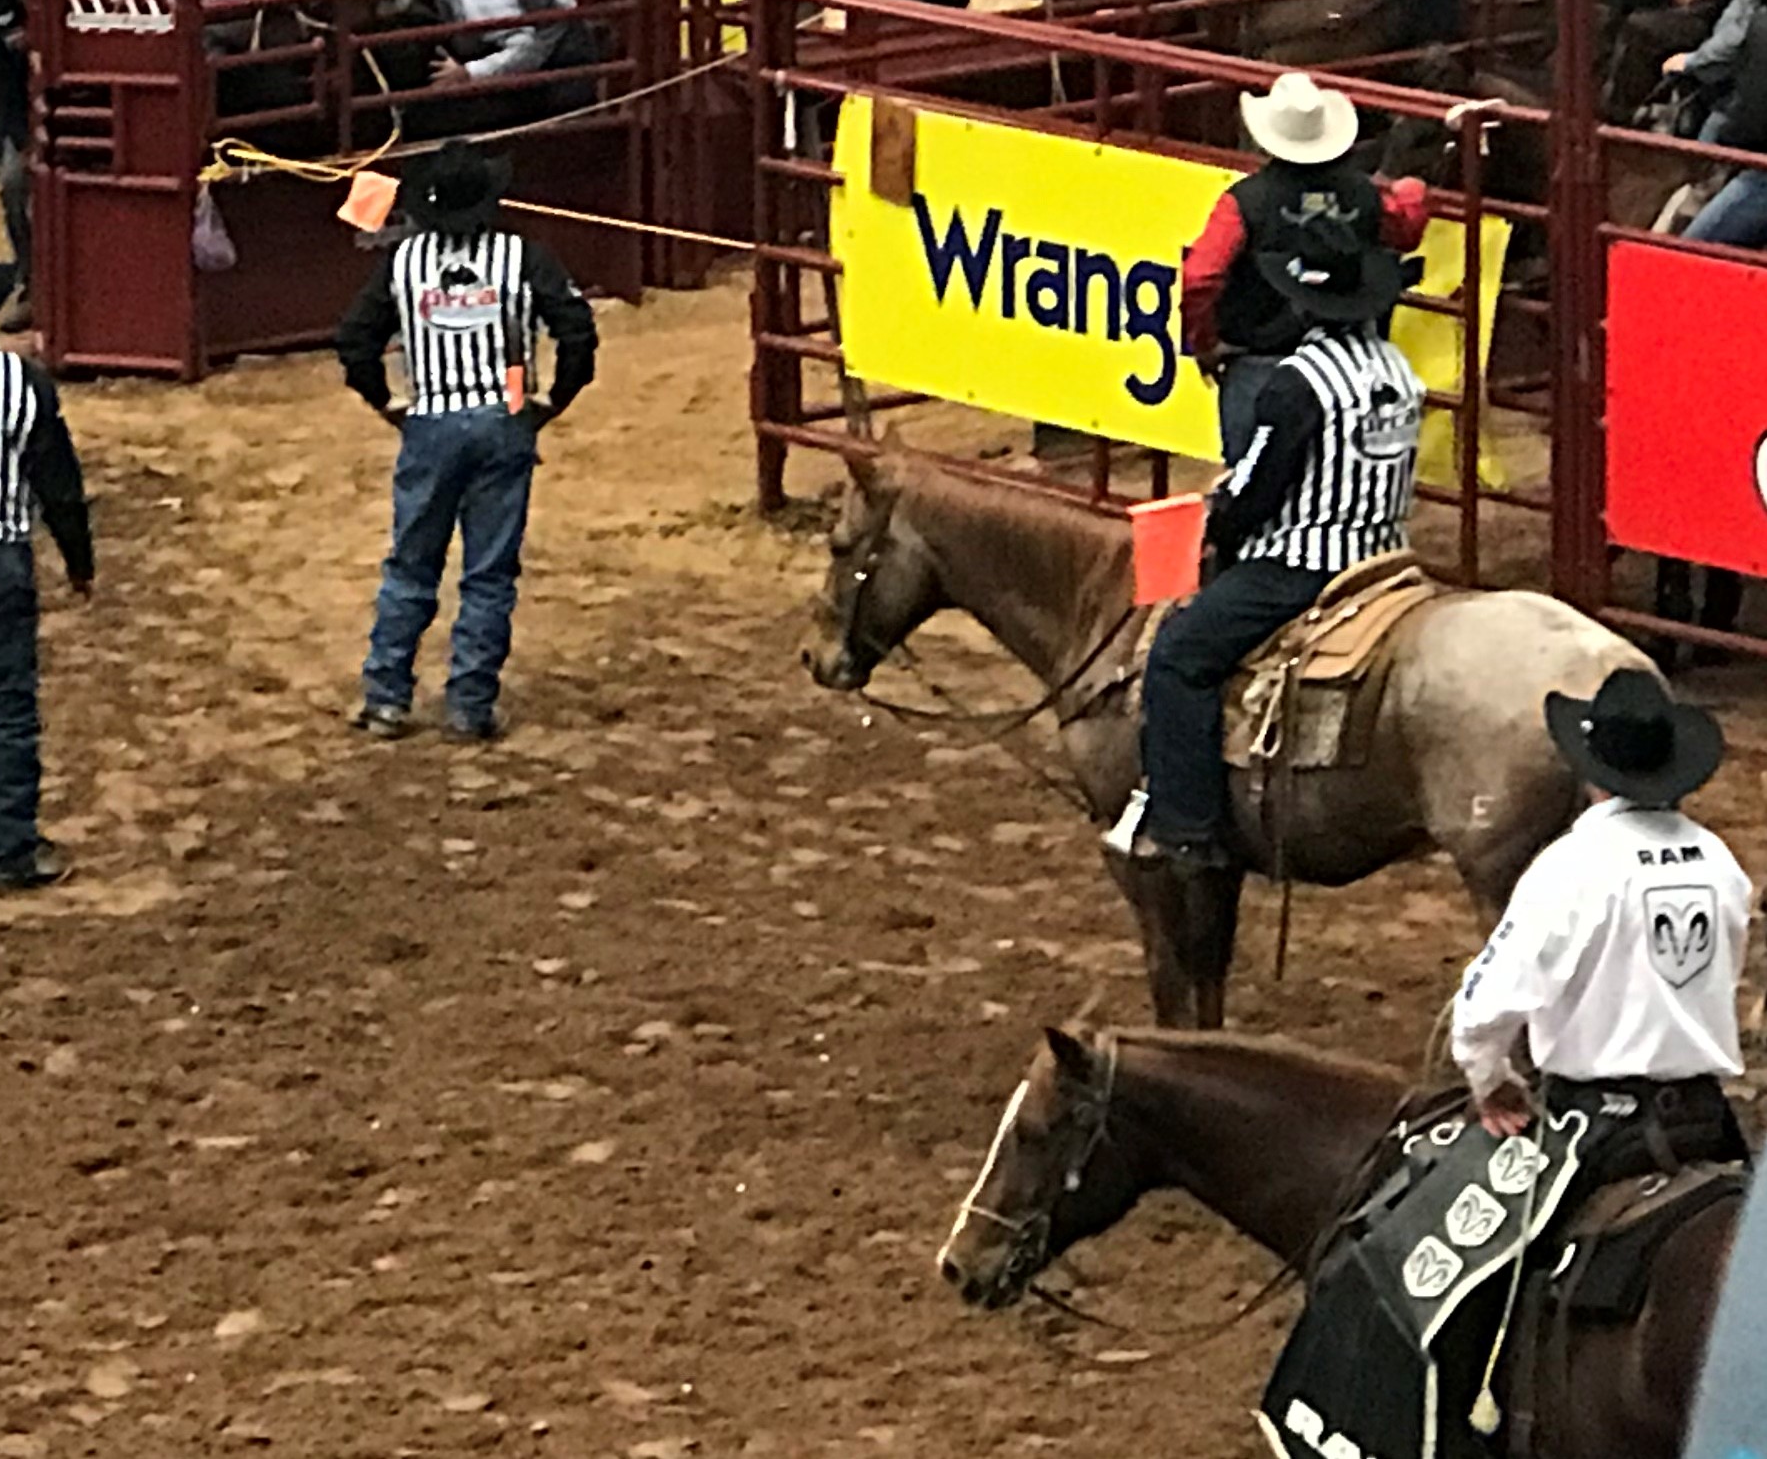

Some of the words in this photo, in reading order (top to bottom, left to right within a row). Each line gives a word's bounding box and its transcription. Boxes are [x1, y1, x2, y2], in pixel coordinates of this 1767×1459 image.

[912, 192, 1184, 405] Wrang
[1637, 846, 1705, 865] RAM
[1285, 1398, 1378, 1459] RA
